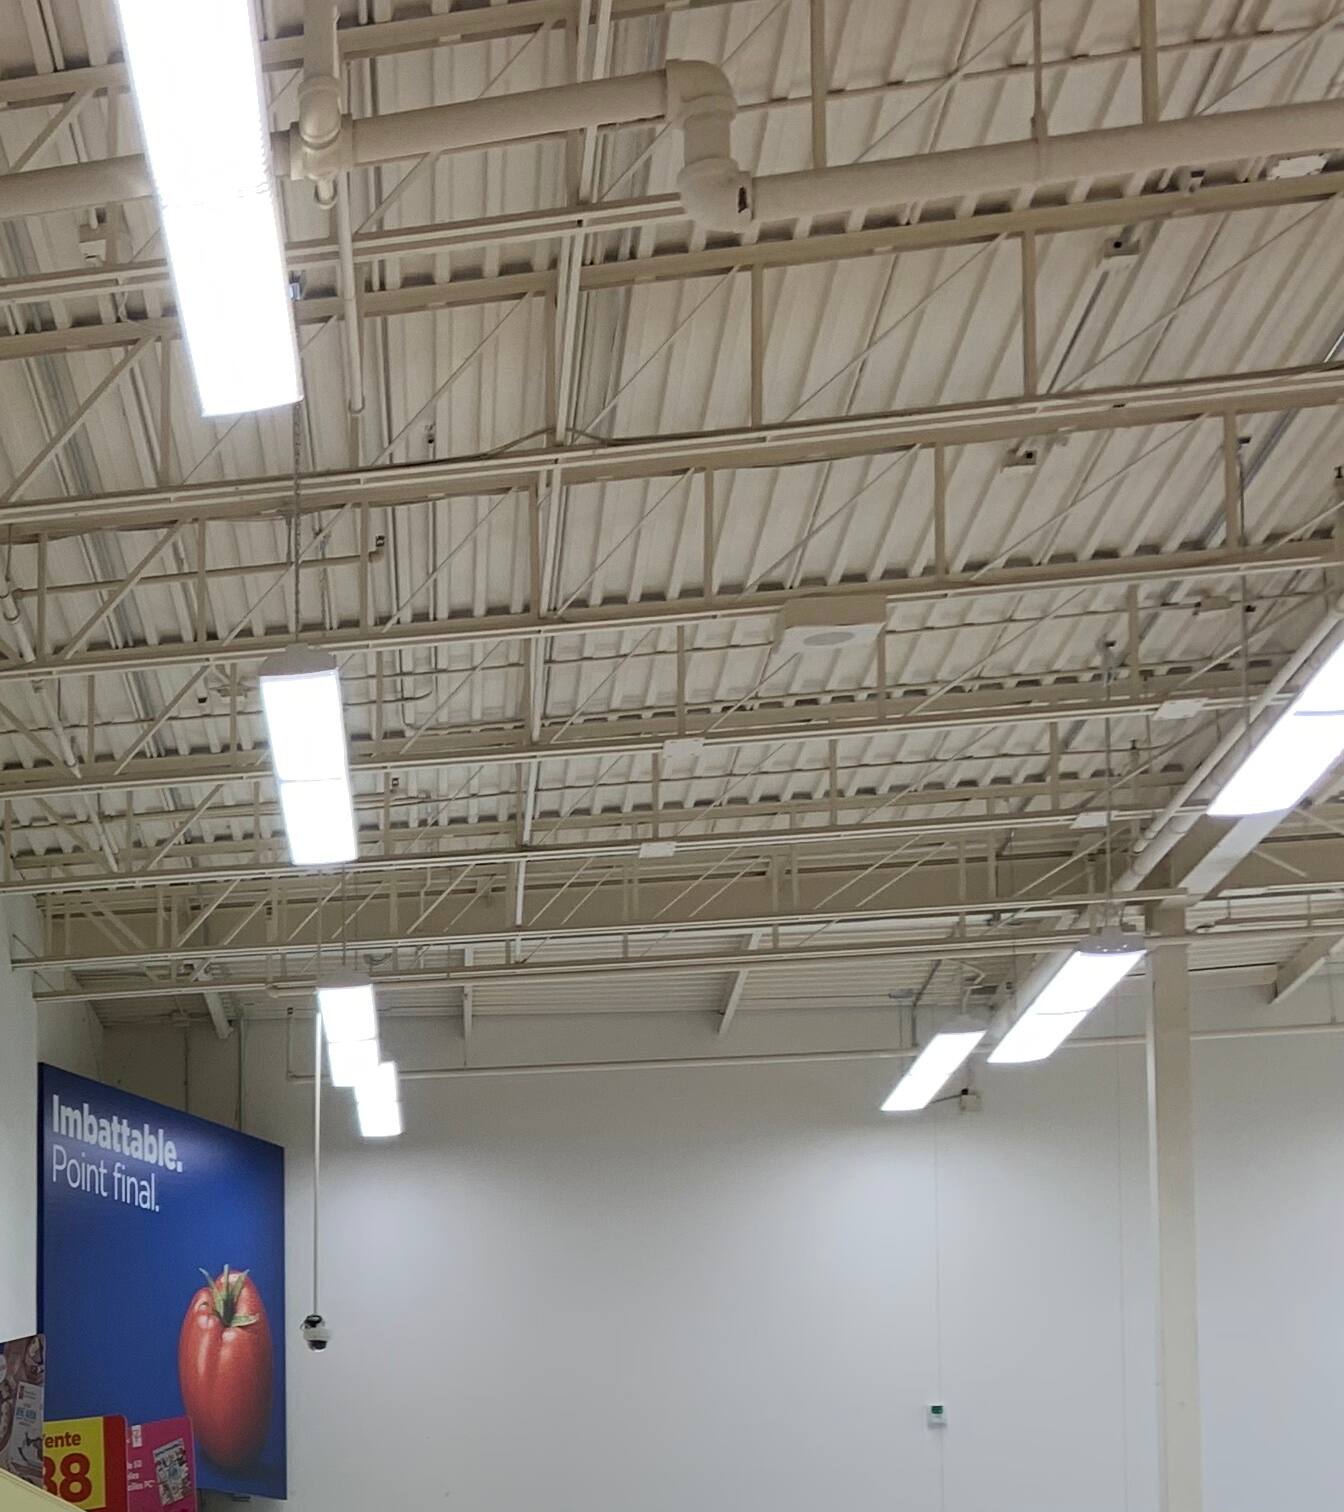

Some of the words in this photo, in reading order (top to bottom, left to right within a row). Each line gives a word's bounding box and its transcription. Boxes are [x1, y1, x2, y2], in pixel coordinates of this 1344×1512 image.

[52, 1094, 183, 1172] Imbattable.
[53, 1144, 108, 1197] Point
[113, 1162, 160, 1212] final.
[43, 1432, 81, 1449] ente
